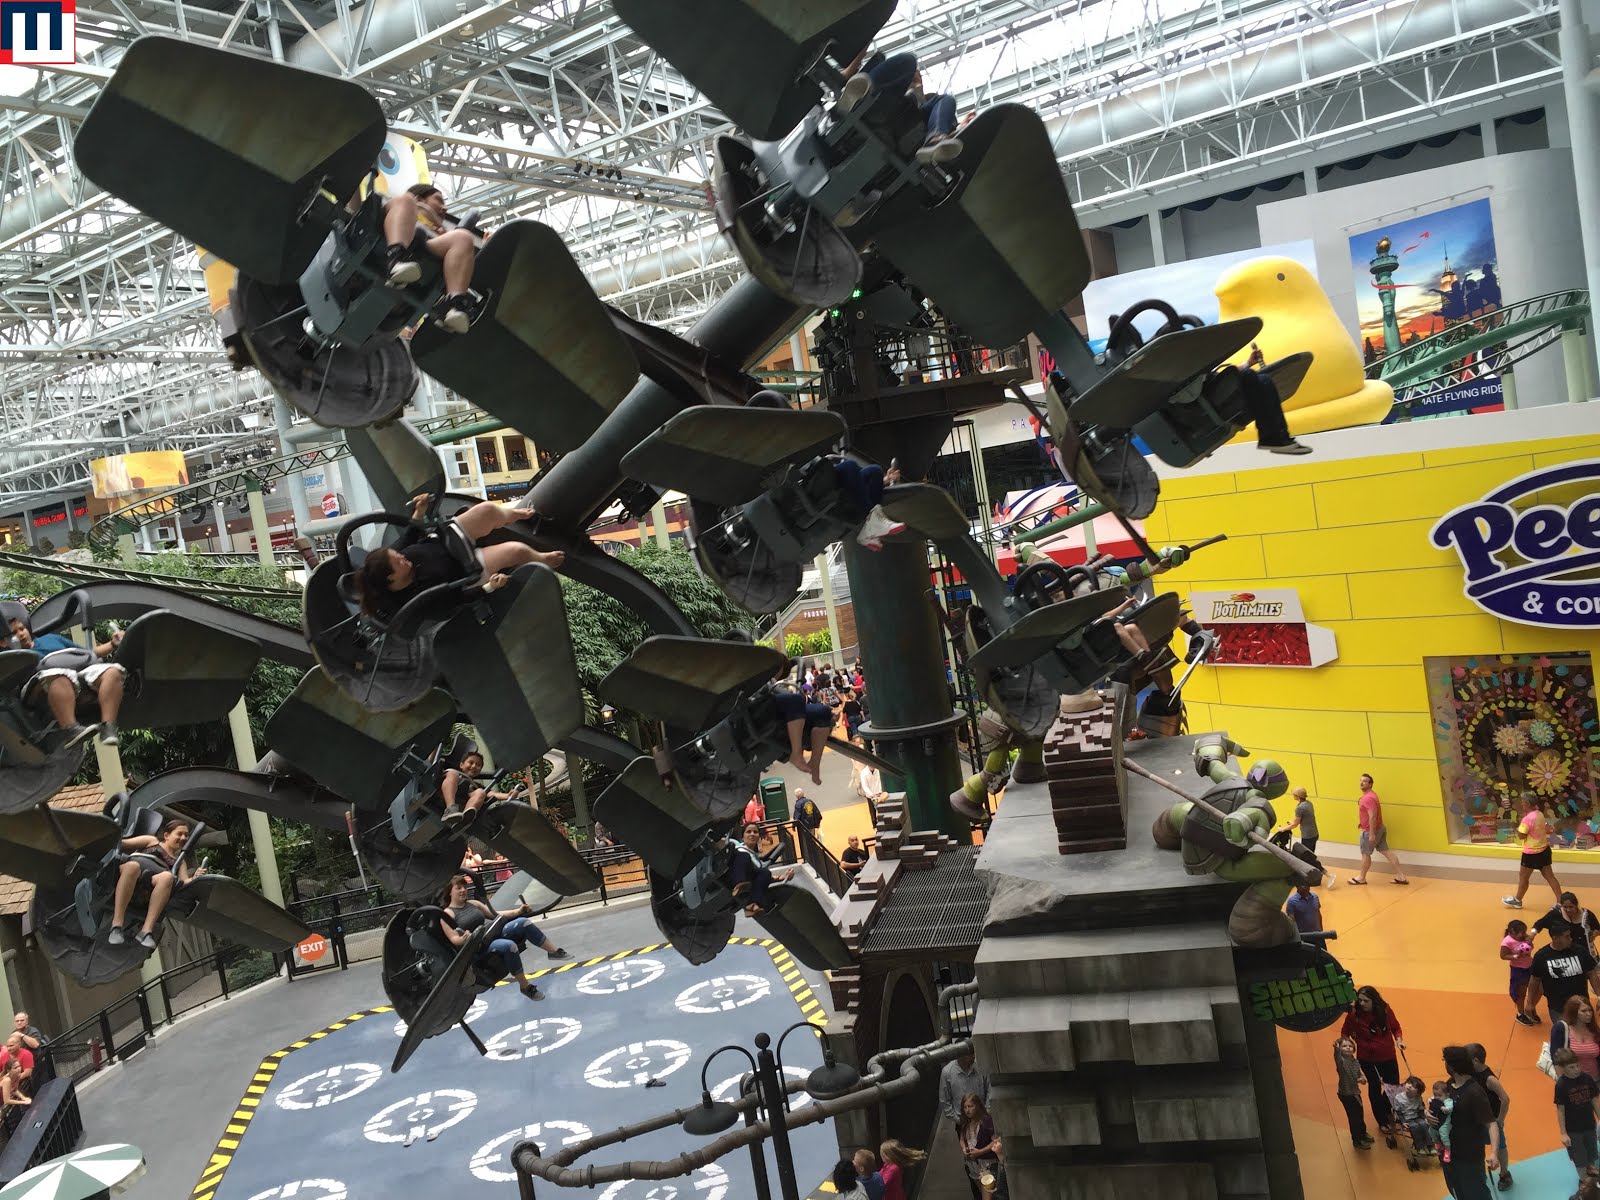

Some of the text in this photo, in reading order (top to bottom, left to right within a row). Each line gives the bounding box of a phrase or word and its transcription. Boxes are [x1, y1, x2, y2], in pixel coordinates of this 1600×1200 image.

[1445, 388, 1480, 401] FLYING
[1481, 384, 1503, 396] RIDE
[1522, 591, 1544, 615] &
[300, 941, 324, 954] EXIT
